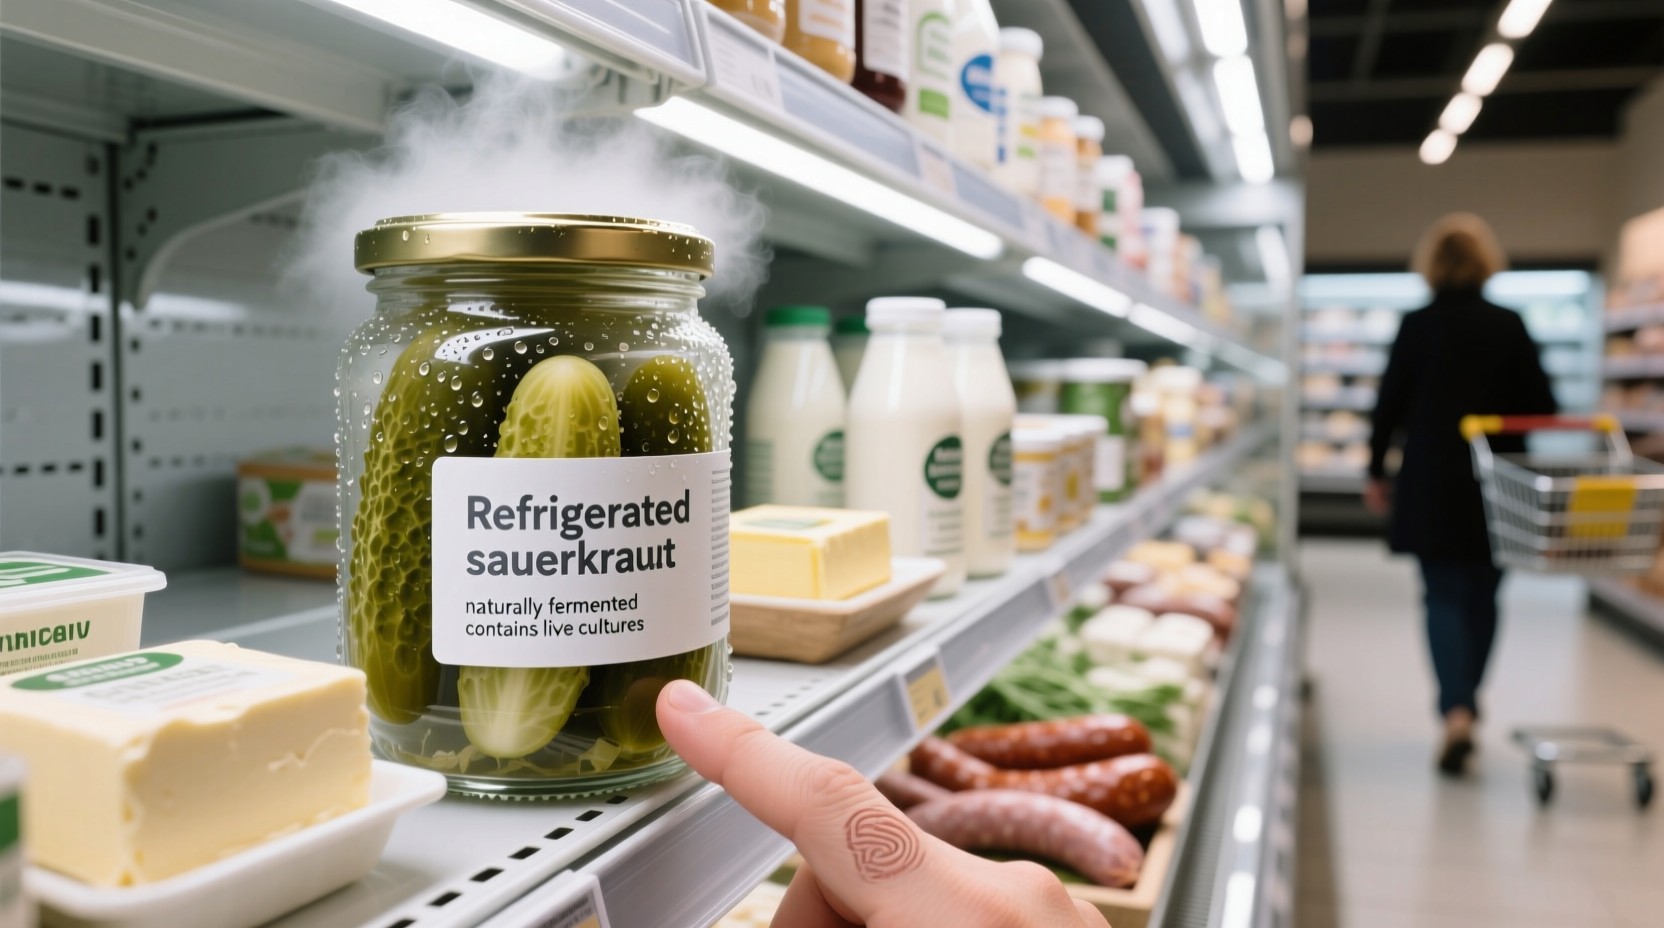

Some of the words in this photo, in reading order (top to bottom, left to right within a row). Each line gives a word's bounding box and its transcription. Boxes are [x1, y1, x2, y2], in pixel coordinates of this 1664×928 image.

[467, 489, 690, 540] Refrigerated
[466, 597, 543, 619] naturally
[548, 593, 638, 614] fermented
[466, 620, 538, 637] contains
[543, 619, 573, 637] live
[578, 618, 645, 635] cultures
